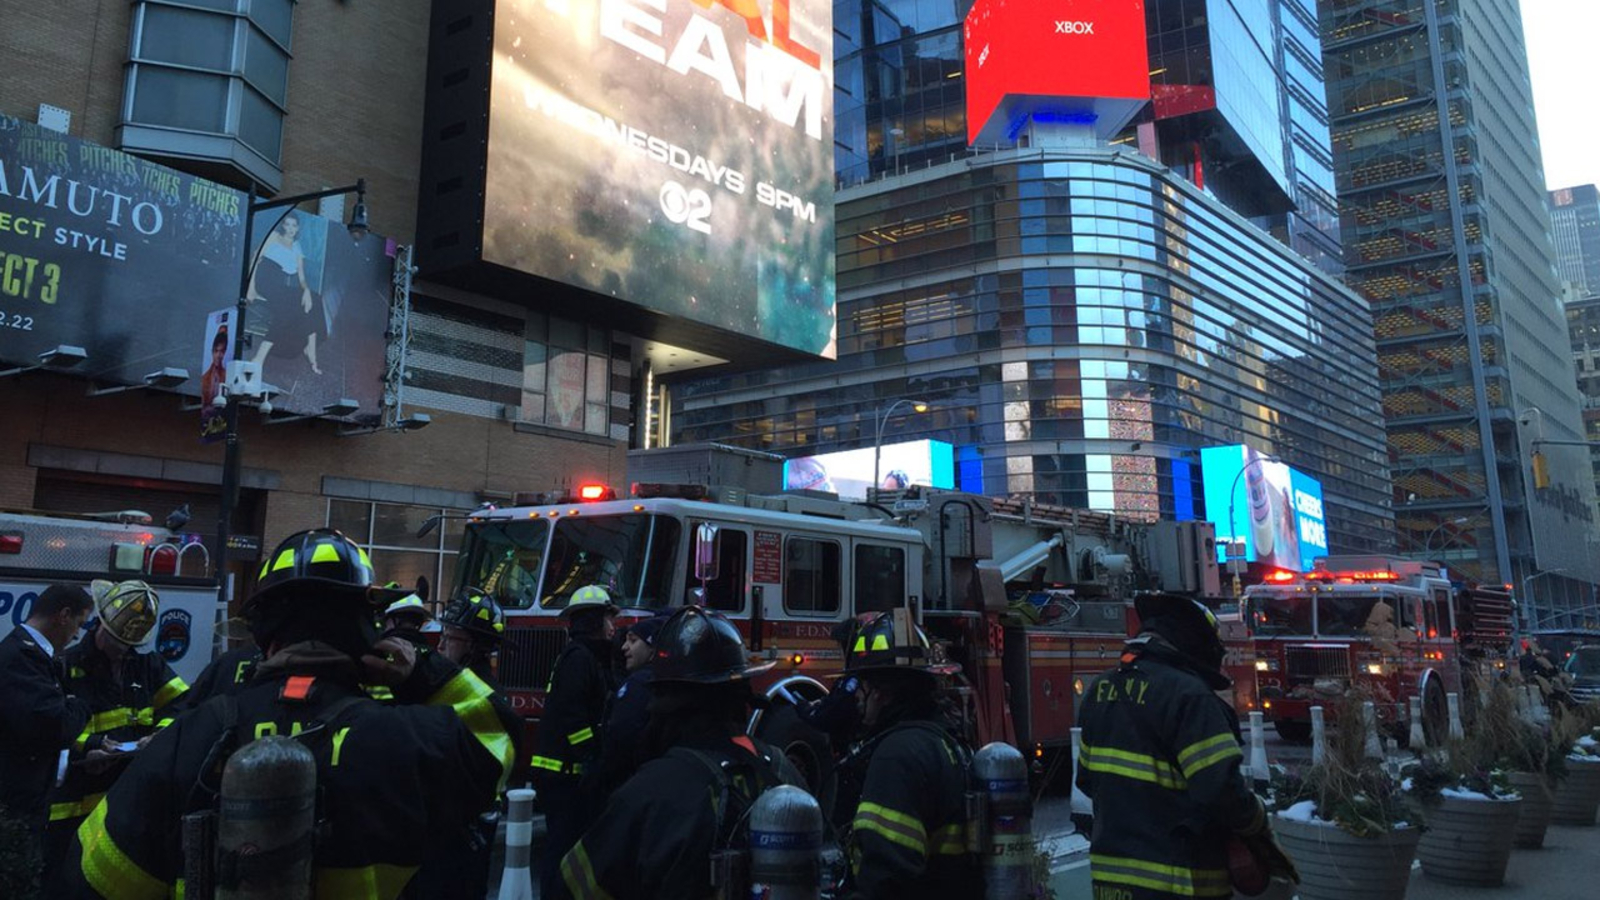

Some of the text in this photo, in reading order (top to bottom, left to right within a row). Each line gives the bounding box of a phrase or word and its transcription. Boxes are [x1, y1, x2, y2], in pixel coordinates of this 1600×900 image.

[1054, 20, 1094, 34] XBOX
[545, 0, 823, 141] EAM
[522, 83, 816, 223] WDNESDAYS 9PM
[189, 181, 240, 217] PITCHES
[54, 227, 128, 261] STYLE
[40, 262, 61, 305] 3
[161, 610, 190, 626] POLICE
